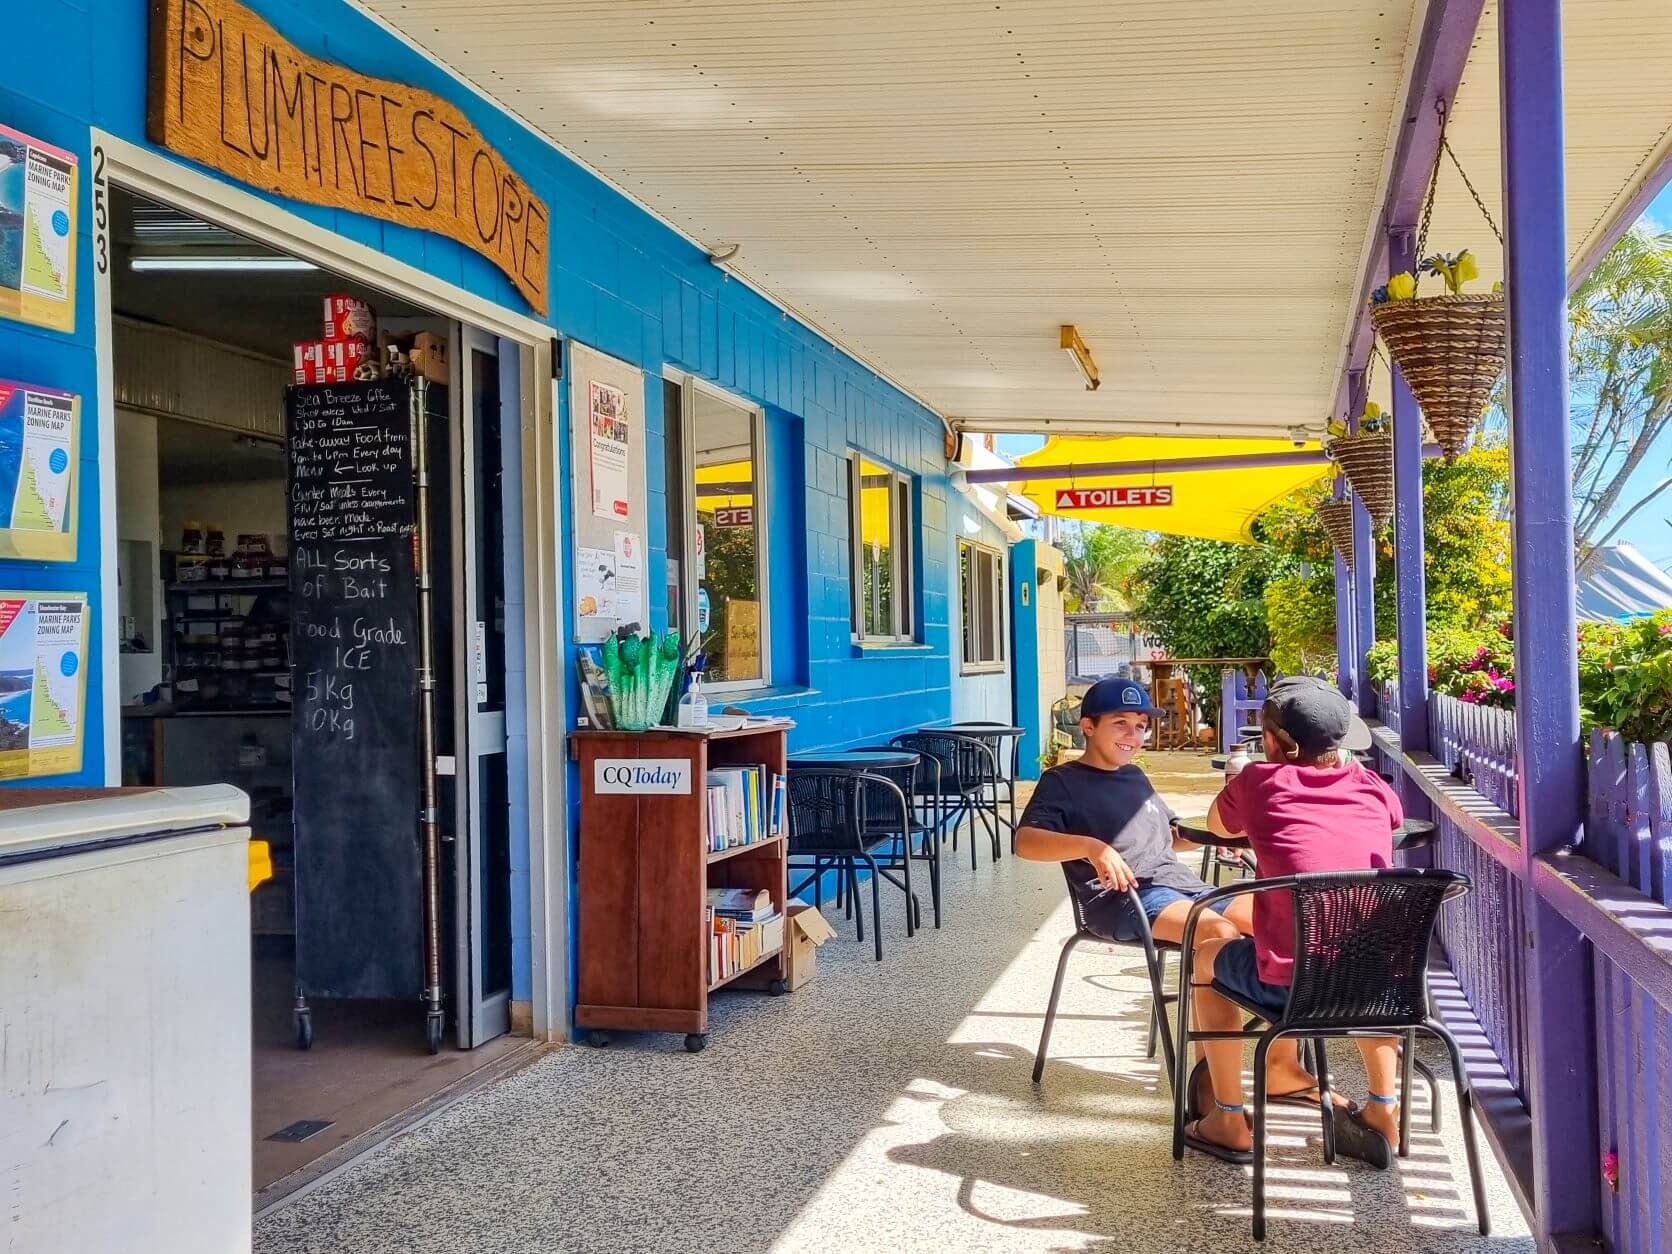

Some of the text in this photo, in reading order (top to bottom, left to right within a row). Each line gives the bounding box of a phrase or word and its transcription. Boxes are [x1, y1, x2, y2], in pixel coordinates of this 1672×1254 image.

[28, 160, 53, 178] MARINE
[27, 171, 66, 193] ZONING MAP
[93, 145, 108, 275] 253
[296, 388, 320, 408] Sea
[323, 388, 361, 405] Breeze
[27, 406, 71, 422] MARINE PARKS
[331, 417, 354, 426] 10am
[26, 416, 65, 431] ZONING MAP
[355, 428, 381, 444] Food
[383, 428, 408, 441] from
[353, 447, 379, 459] Every
[382, 445, 402, 460] day
[356, 461, 380, 473] Look
[383, 463, 397, 472] up
[361, 487, 387, 499] Every
[1076, 488, 1171, 506] TOILETS
[340, 524, 365, 537] night
[333, 549, 391, 572] Sorts
[302, 573, 388, 599] of Bait
[38, 614, 81, 624] MARINE PARKS
[37, 625, 74, 635] ZONING MAP
[353, 616, 407, 649] Grade
[335, 646, 372, 670] ICE
